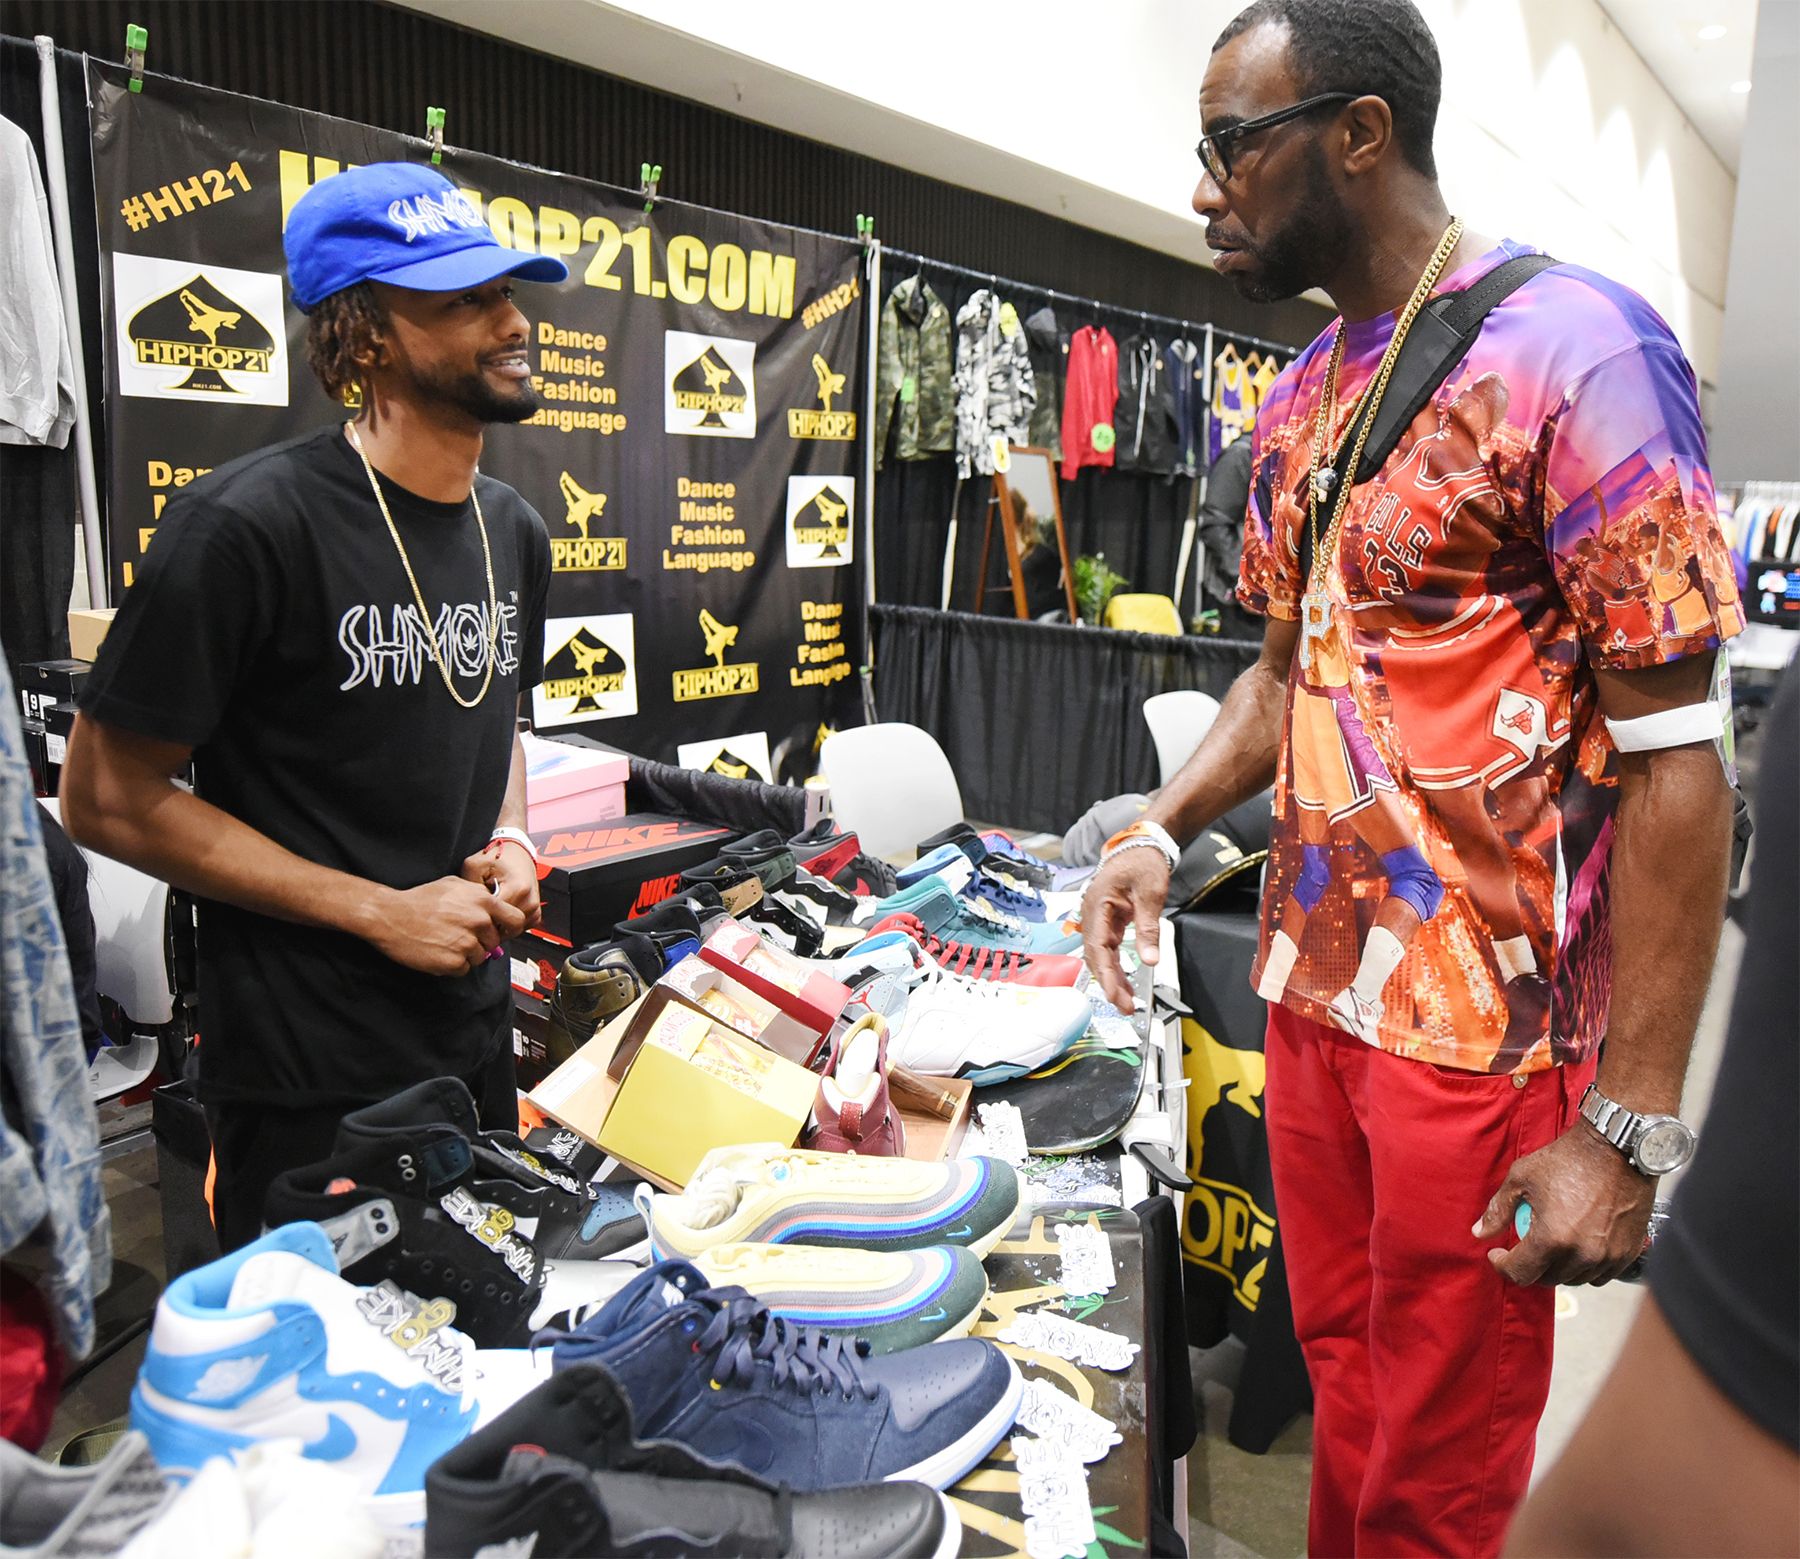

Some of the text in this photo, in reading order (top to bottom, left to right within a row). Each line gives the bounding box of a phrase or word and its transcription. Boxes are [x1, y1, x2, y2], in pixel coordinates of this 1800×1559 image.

[121, 161, 252, 232] #HH21
[538, 322, 607, 352] Dance
[139, 340, 267, 372] HIPHOP21
[541, 350, 605, 378] Music
[530, 376, 617, 404] Fashion
[792, 412, 856, 438] HIPHOP2
[677, 477, 736, 499] Dance
[680, 501, 735, 522] Music
[671, 524, 746, 546] Fashion
[550, 541, 624, 568] PHOP21
[662, 548, 756, 573] Language
[547, 674, 624, 699] HIPHOP21
[675, 667, 756, 698] HIPHOP21
[543, 823, 679, 855] NIKE
[637, 873, 682, 908] NIKE
